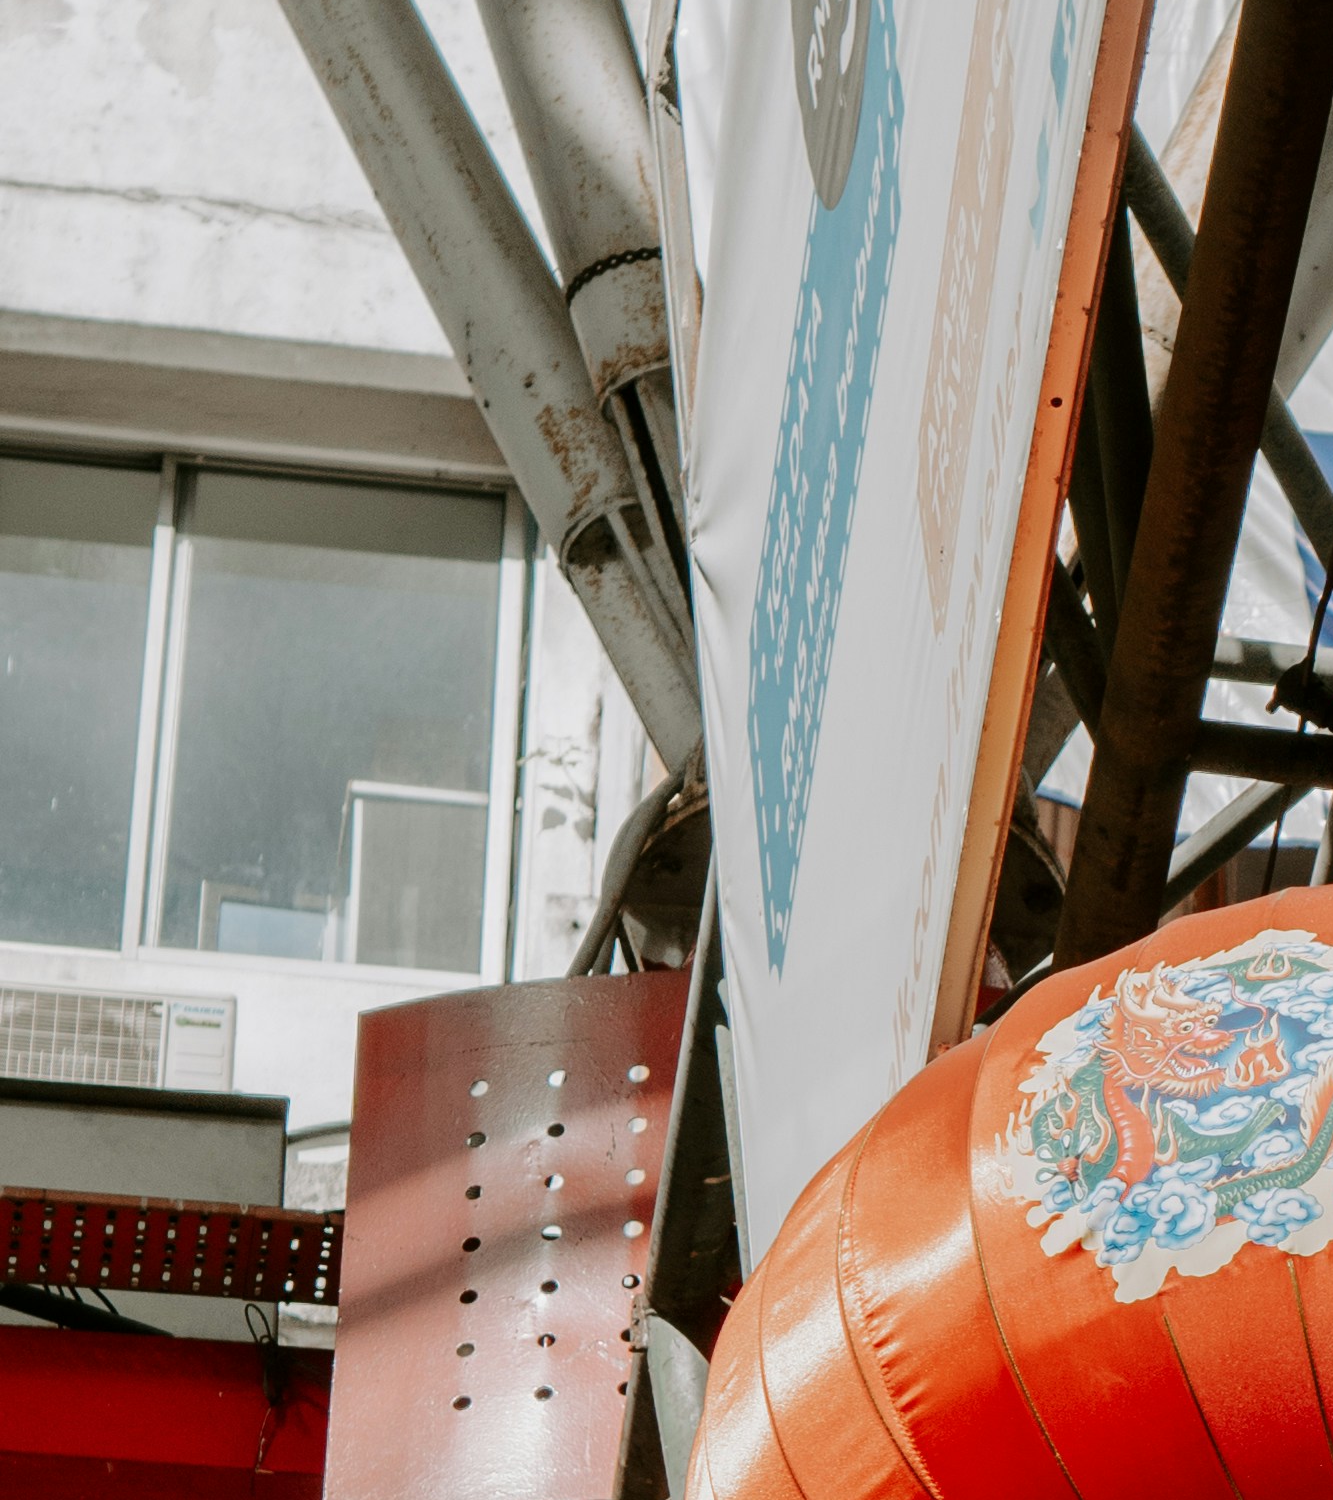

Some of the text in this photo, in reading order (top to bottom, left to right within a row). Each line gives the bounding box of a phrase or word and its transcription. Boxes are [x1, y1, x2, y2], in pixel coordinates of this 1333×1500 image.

[765, 287, 822, 642] 1GB DATA
[781, 112, 884, 801] RM5 Masa berbual
[788, 470, 809, 599] DATA
